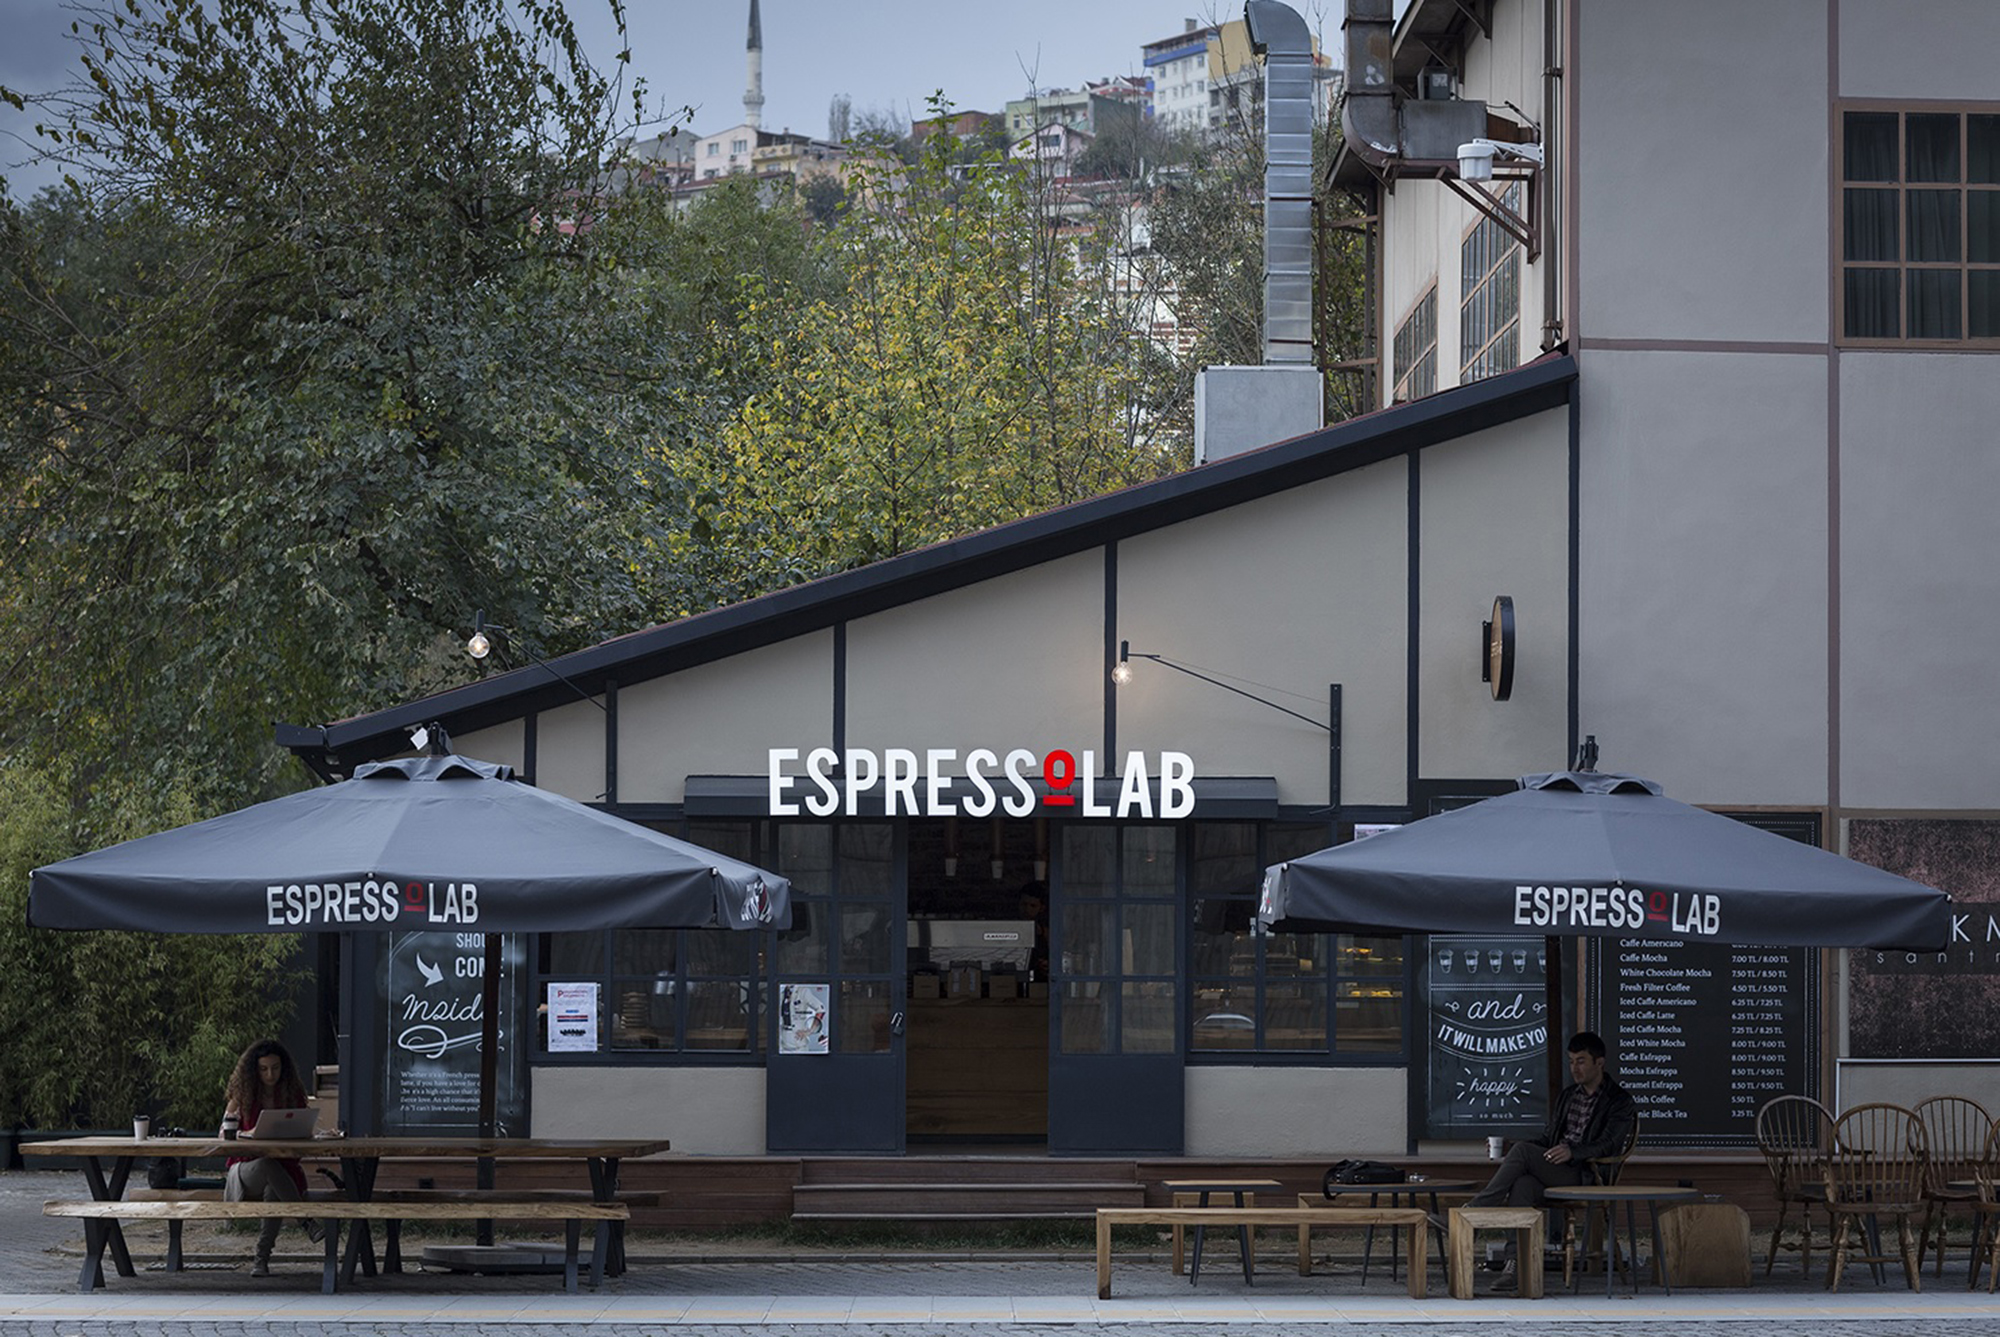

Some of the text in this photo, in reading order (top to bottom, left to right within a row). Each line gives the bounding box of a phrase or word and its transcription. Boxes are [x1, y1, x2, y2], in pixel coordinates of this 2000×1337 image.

[1620, 938, 1640, 948] Caffe
[1620, 953, 1668, 962] Caffe Mocha
[1620, 968, 1712, 977] White Chocolate Mocha
[1620, 983, 1691, 992] Fresh Filter Coffee
[1467, 993, 1525, 1019] and
[1620, 998, 1697, 1006] Iced Caffe Americano
[402, 993, 503, 1021] Insid
[1620, 1011, 1675, 1019] Iced Caffe Latte
[1620, 1025, 1682, 1033] Iced Caffe Mocha
[1437, 1024, 1454, 1041] IT
[1453, 1030, 1484, 1053] WILL
[1486, 1033, 1527, 1053] MAKE
[1620, 1039, 1686, 1047] Iced White Mocha
[1619, 1053, 1639, 1061] Caffe
[1620, 1067, 1644, 1075] Mocha
[1470, 1078, 1518, 1096] happy
[1620, 1081, 1650, 1089] Caramel
[1650, 1095, 1676, 1104] Coffee
[1491, 1111, 1514, 1119] much
[1651, 1109, 1673, 1118] Black
[1673, 1109, 1688, 1118] Tea
